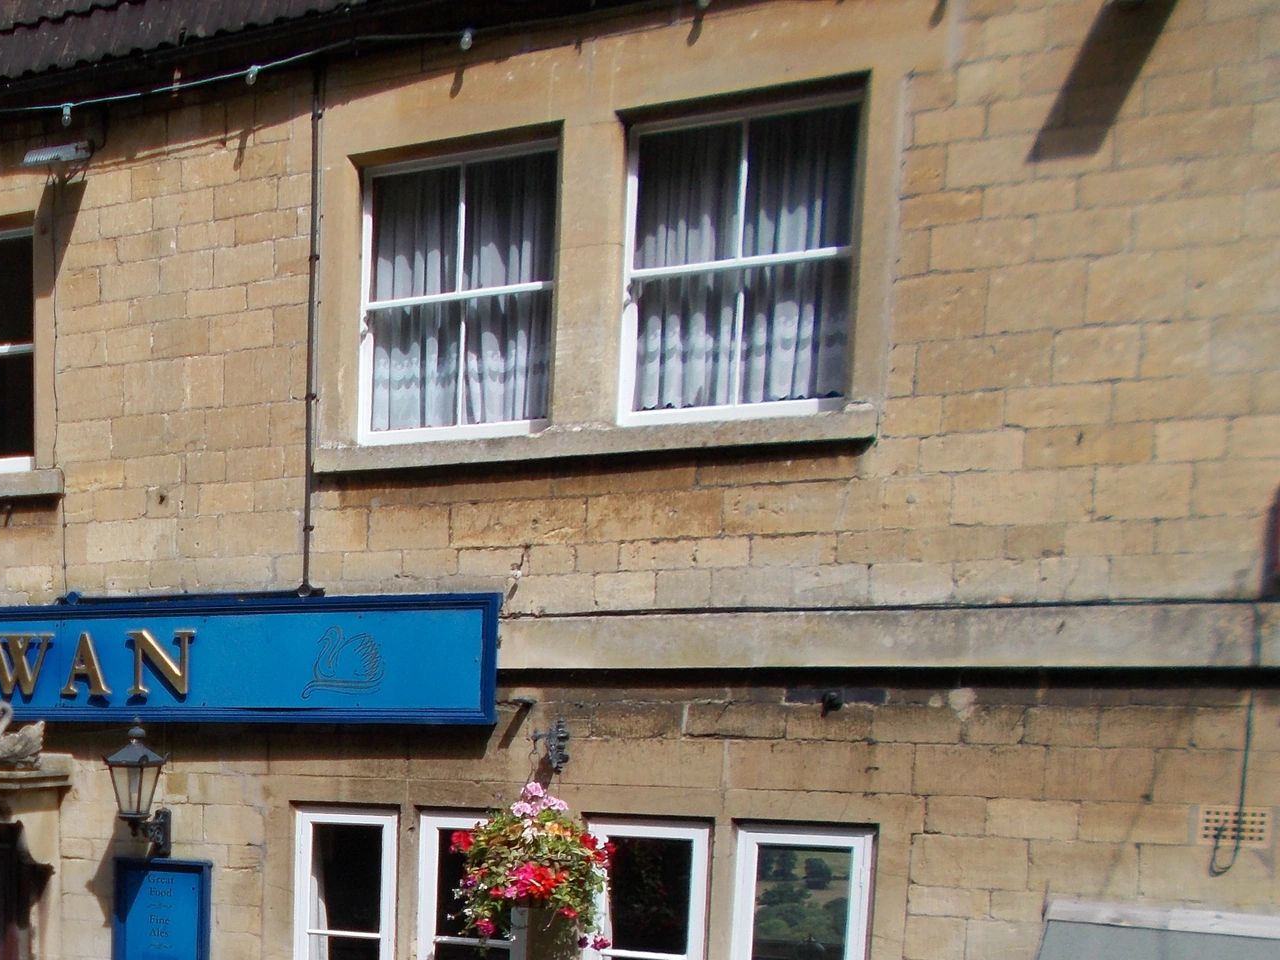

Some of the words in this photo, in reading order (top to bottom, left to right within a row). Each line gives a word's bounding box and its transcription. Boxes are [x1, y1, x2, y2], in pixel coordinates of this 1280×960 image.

[148, 875, 174, 884] Great
[149, 888, 172, 897] Food
[149, 914, 170, 925] Fine
[149, 928, 169, 937] Ales
